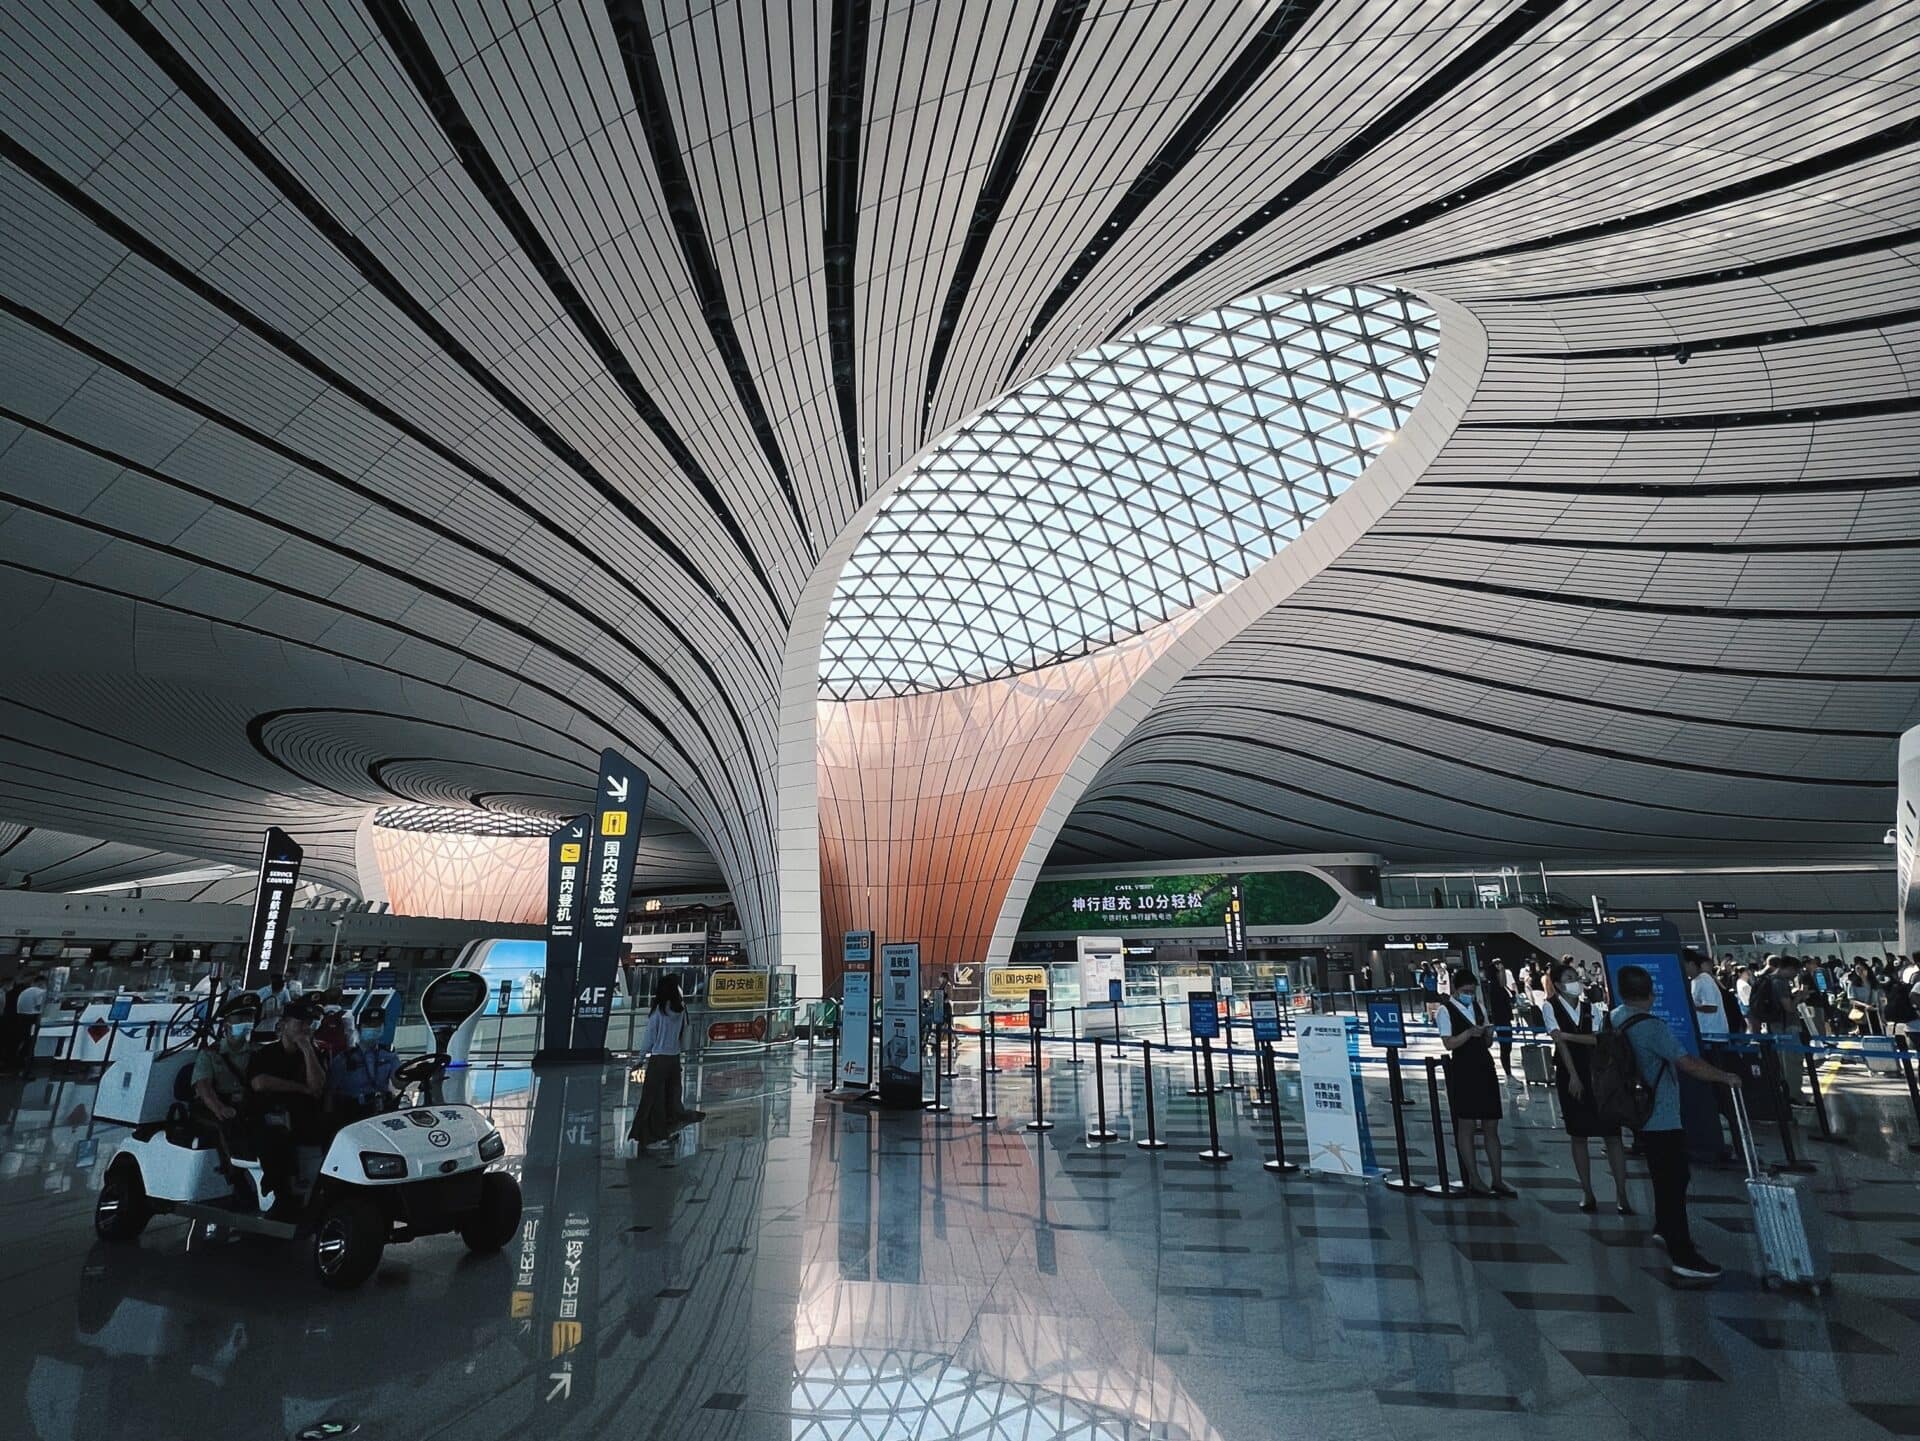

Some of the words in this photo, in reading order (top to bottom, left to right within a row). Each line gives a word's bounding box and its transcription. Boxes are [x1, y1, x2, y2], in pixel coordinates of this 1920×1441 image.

[599, 841, 620, 904] 国内安检
[266, 877, 294, 885] COUNTER
[556, 866, 576, 922] 国内登机
[1072, 895, 1132, 912] 神行超充
[1137, 892, 1203, 910] 10分轻松
[715, 978, 754, 991] 国内安检
[1005, 974, 1042, 985] 国内安检
[579, 986, 607, 1005] 4F
[1373, 1011, 1399, 1023] 入口
[432, 1133, 447, 1143] 23
